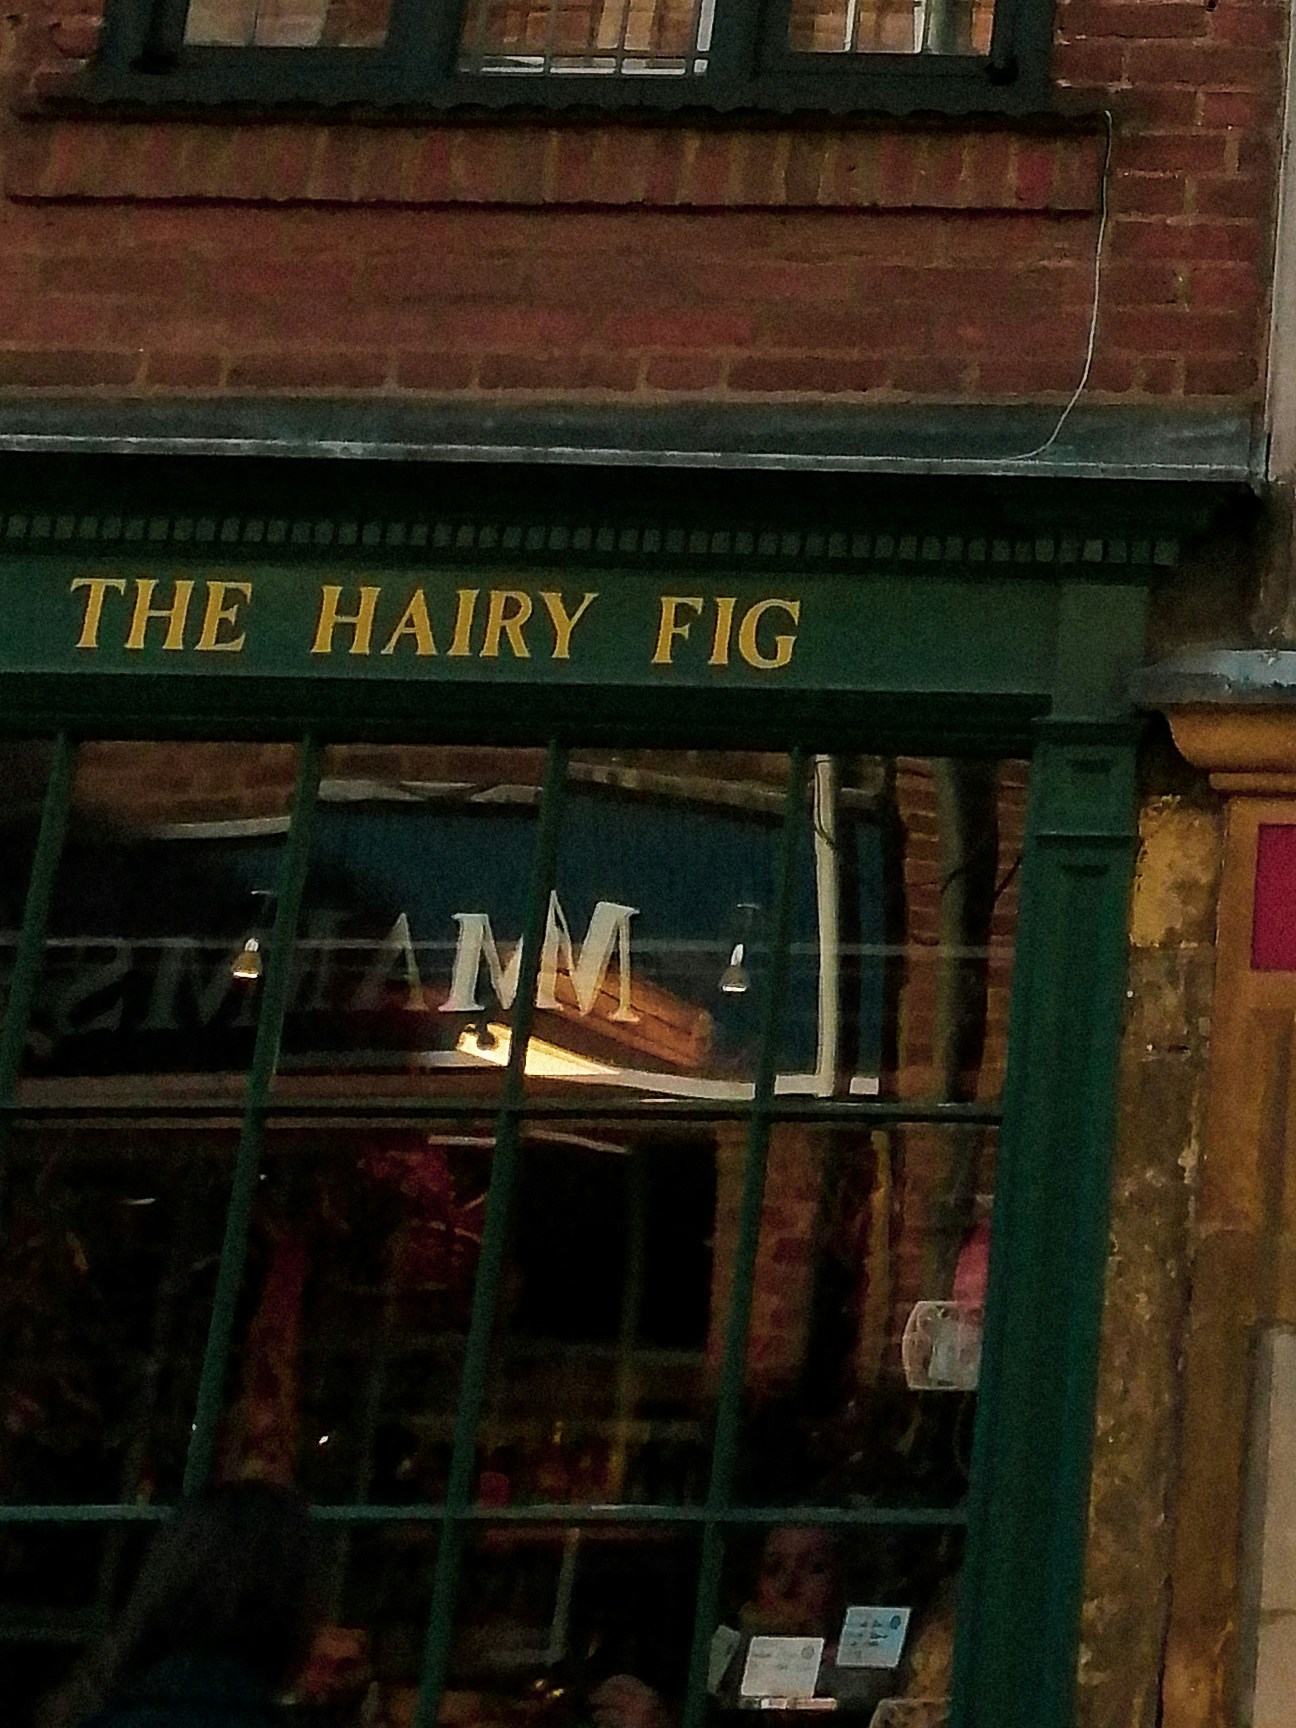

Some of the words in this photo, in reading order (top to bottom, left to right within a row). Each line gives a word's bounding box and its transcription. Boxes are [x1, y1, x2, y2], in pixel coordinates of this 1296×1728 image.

[70, 577, 253, 652] THE
[309, 584, 599, 660] HAIRY
[650, 595, 802, 670] FIG
